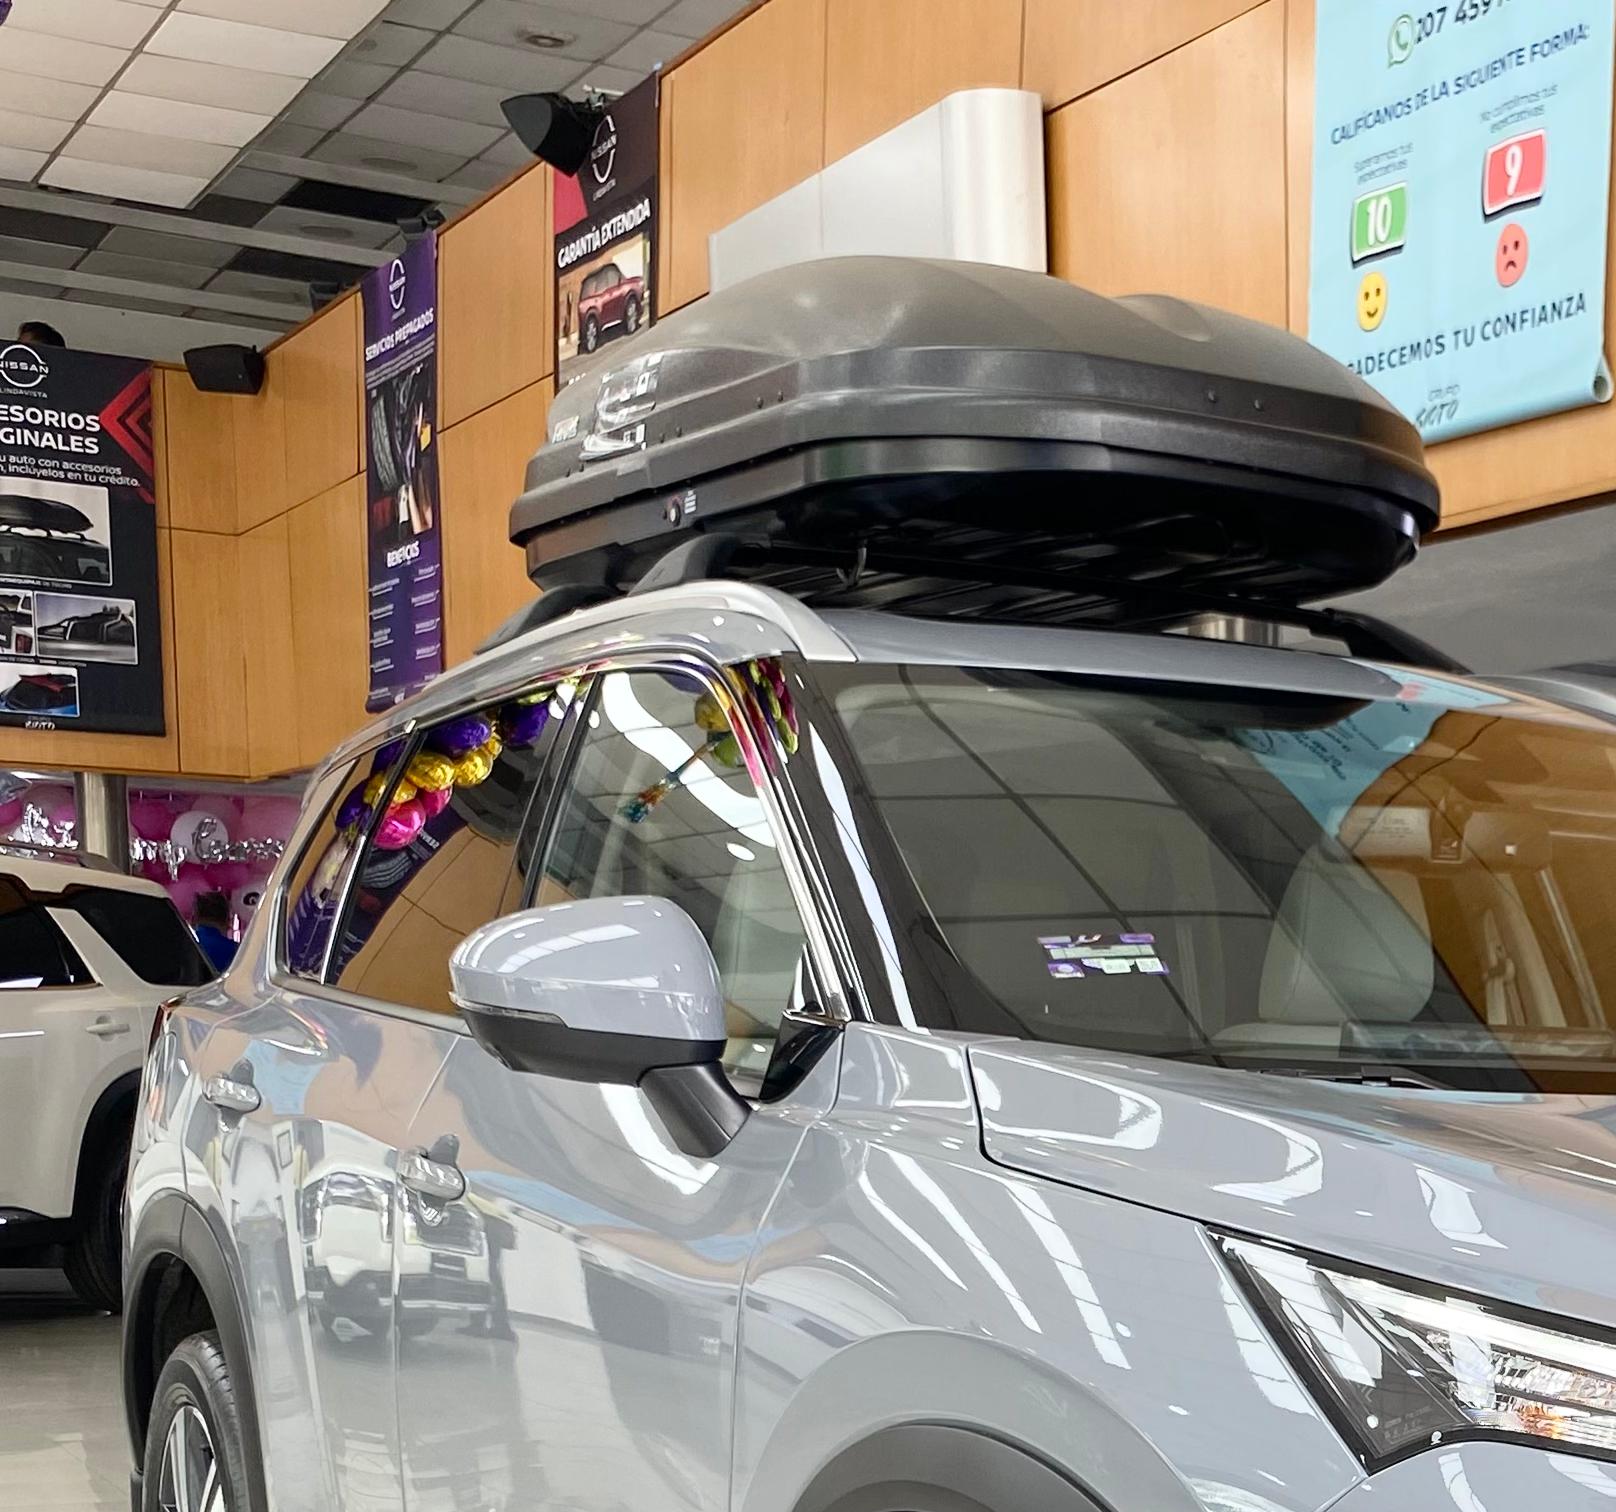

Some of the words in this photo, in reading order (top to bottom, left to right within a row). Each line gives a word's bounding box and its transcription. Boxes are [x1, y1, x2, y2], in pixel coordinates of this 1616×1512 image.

[1431, 80, 1449, 101] LA
[1453, 47, 1525, 95] SIGUIENTE
[1504, 144, 1523, 197] 9
[601, 198, 651, 245] EXTENDIDA
[1367, 194, 1393, 247] 10
[1347, 334, 1445, 376] ADECEMOS
[1453, 326, 1475, 351] TU
[1481, 292, 1586, 341] CONFIANZA
[9, 455, 36, 465] auto
[38, 458, 60, 468] con
[62, 461, 122, 475] accesorios
[67, 471, 81, 480] en
[84, 472, 97, 482] tu
